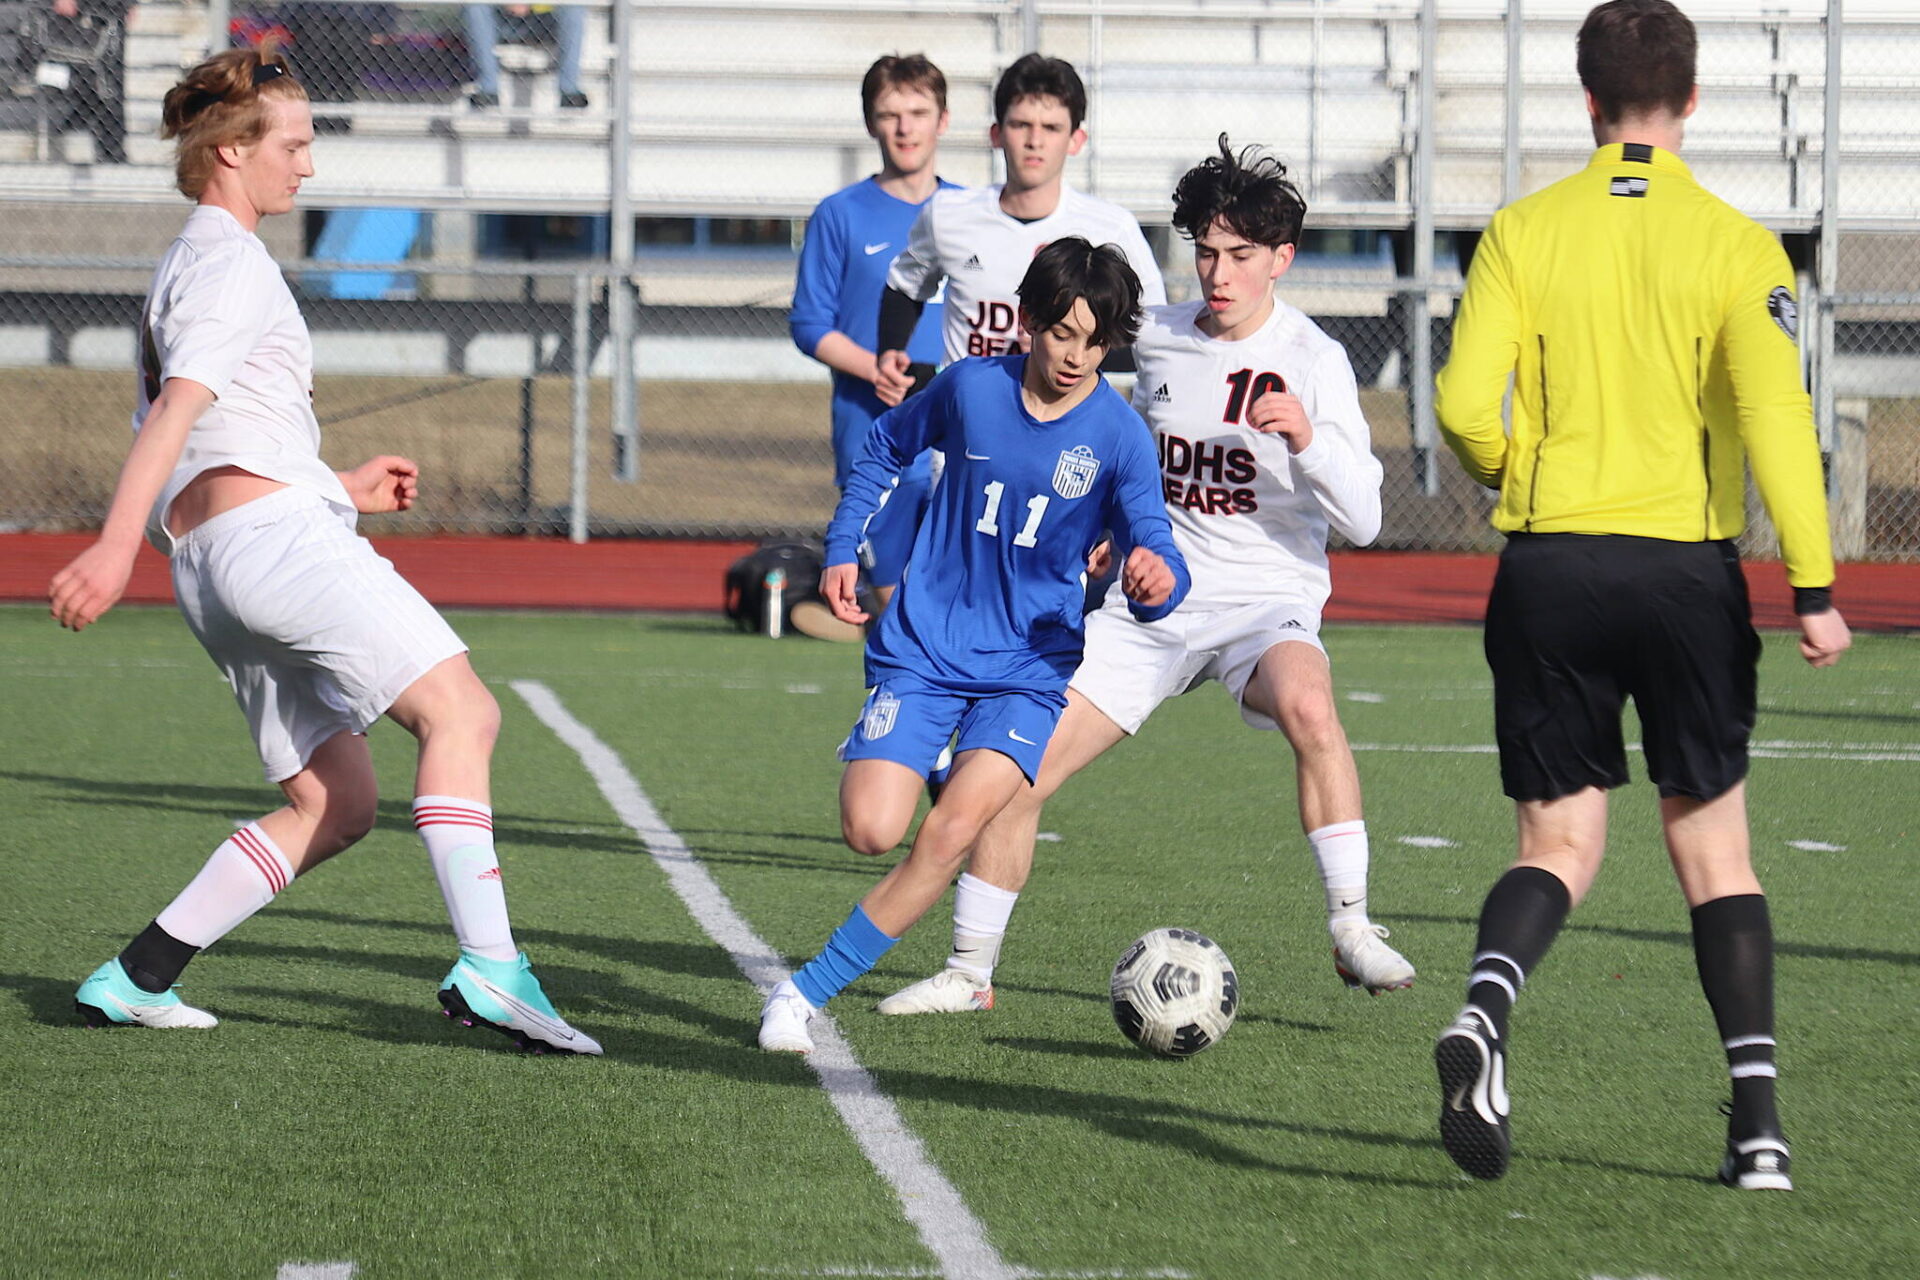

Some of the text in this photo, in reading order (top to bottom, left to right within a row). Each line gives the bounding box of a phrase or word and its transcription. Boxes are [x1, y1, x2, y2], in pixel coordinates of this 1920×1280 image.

[967, 301, 1021, 338] JD
[967, 332, 1021, 356] BEA
[976, 480, 1050, 548] 11
[1162, 478, 1258, 516] EARS
